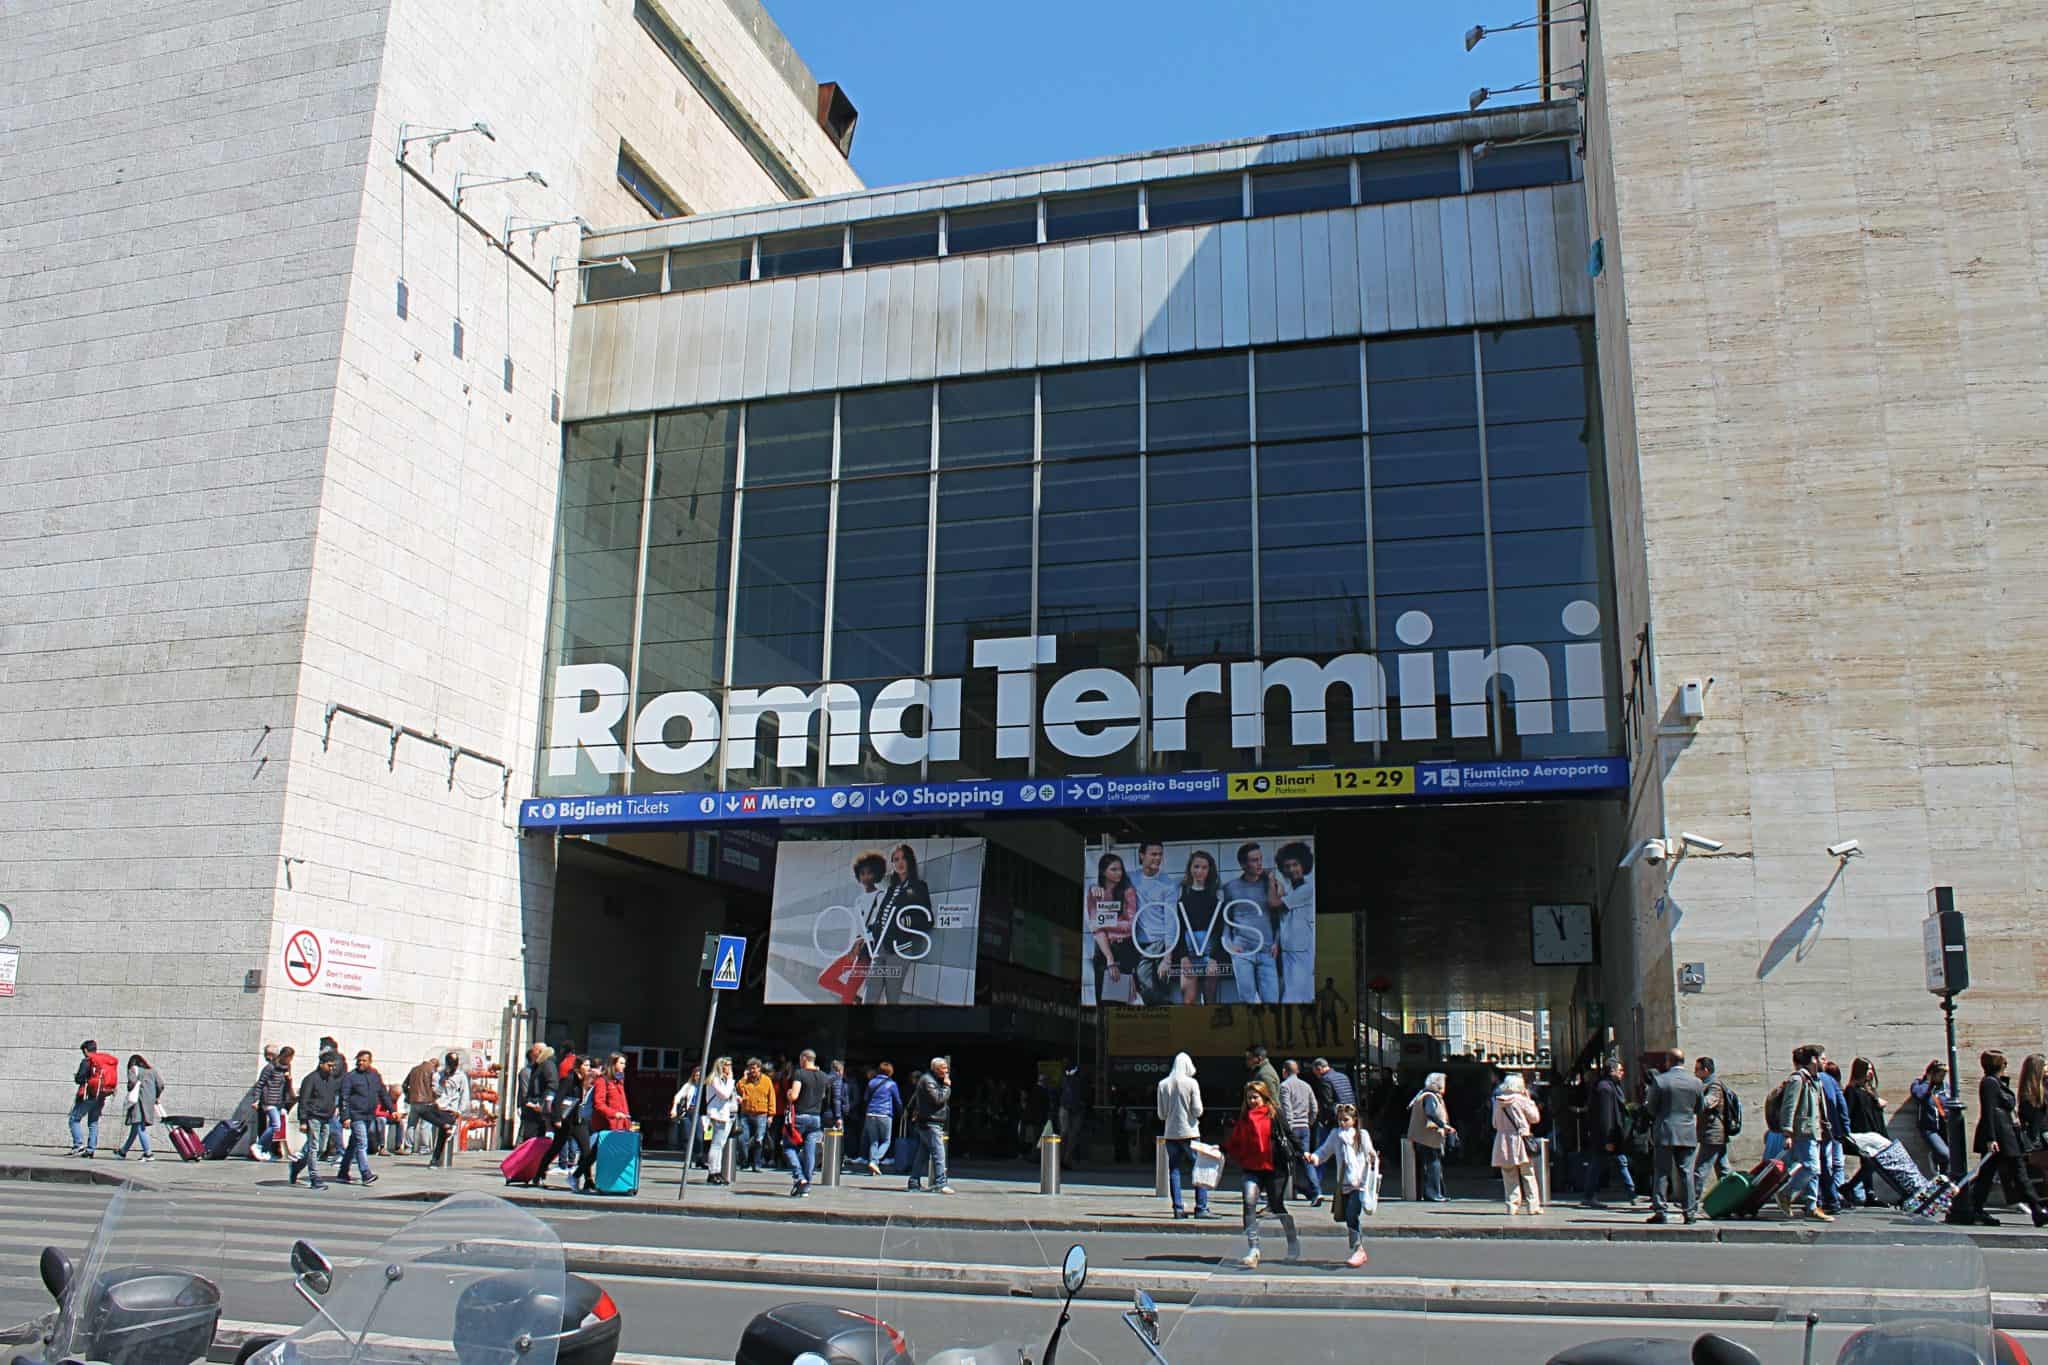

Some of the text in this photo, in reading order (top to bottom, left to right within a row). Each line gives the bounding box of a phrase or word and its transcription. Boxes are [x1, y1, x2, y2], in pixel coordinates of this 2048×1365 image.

[1275, 774, 1316, 786] Binari
[1463, 763, 1609, 780] Fiumicino Aeroporto
[1107, 776, 1221, 794] Deposito Bagagli
[761, 795, 816, 811] Metro
[912, 788, 1004, 806] Shopping
[559, 799, 670, 820] Biglietti Tickets
[813, 904, 934, 960] OVS
[1131, 899, 1264, 958] OVS
